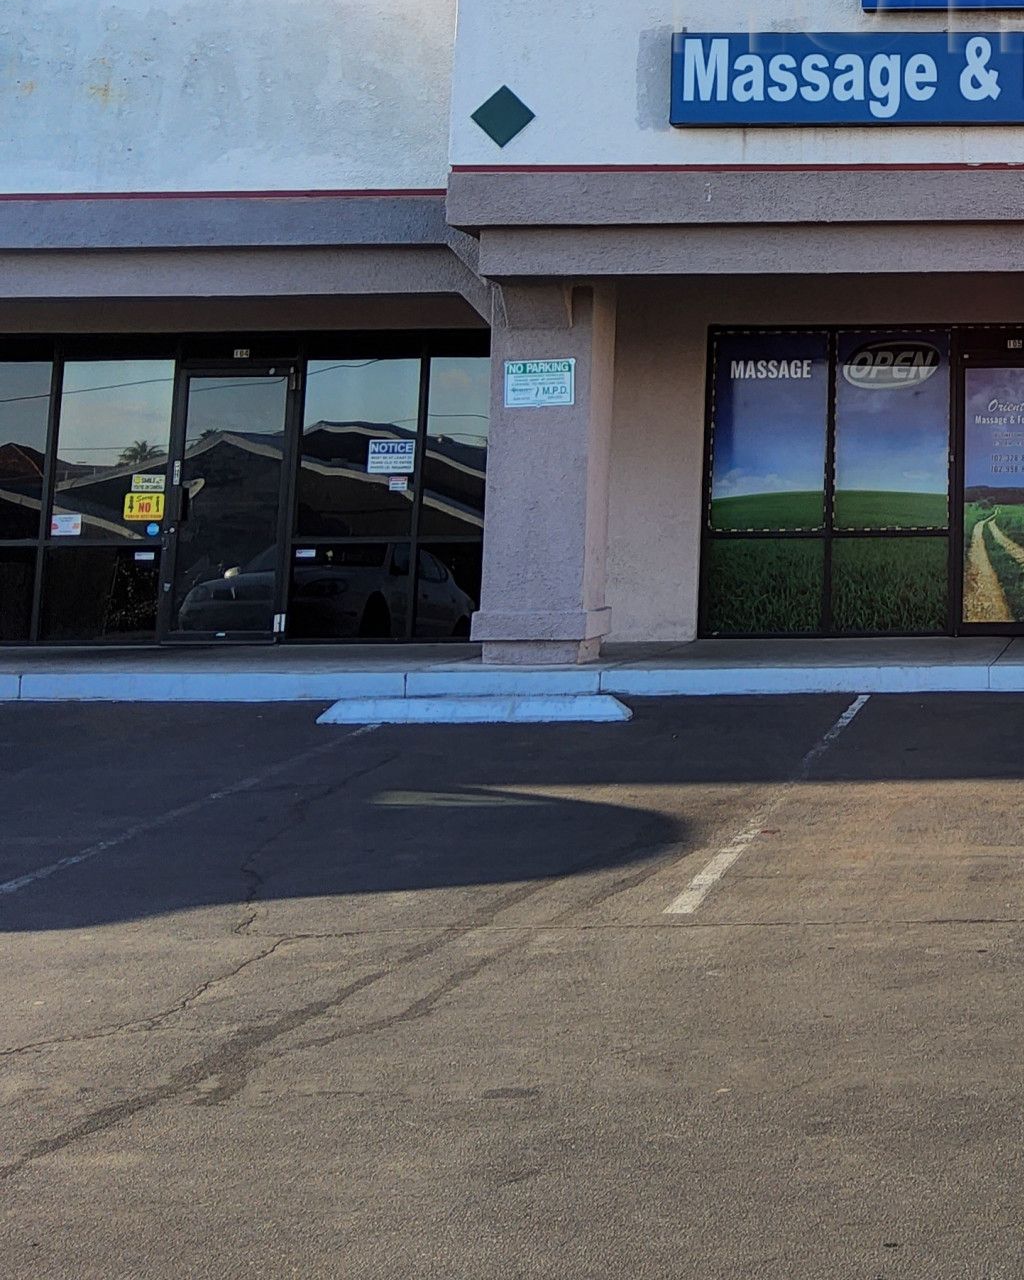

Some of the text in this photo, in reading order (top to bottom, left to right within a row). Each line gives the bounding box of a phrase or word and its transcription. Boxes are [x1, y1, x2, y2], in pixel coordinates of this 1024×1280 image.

[682, 37, 938, 119] Massage
[960, 36, 1002, 101] &
[508, 362, 569, 374] NO PARKING
[730, 359, 812, 379] MASSAGE
[849, 351, 935, 379] OPEN
[975, 415, 1007, 425] Massage
[1010, 415, 1015, 423] &
[371, 442, 413, 453] NOTICE
[138, 502, 152, 512] NO
